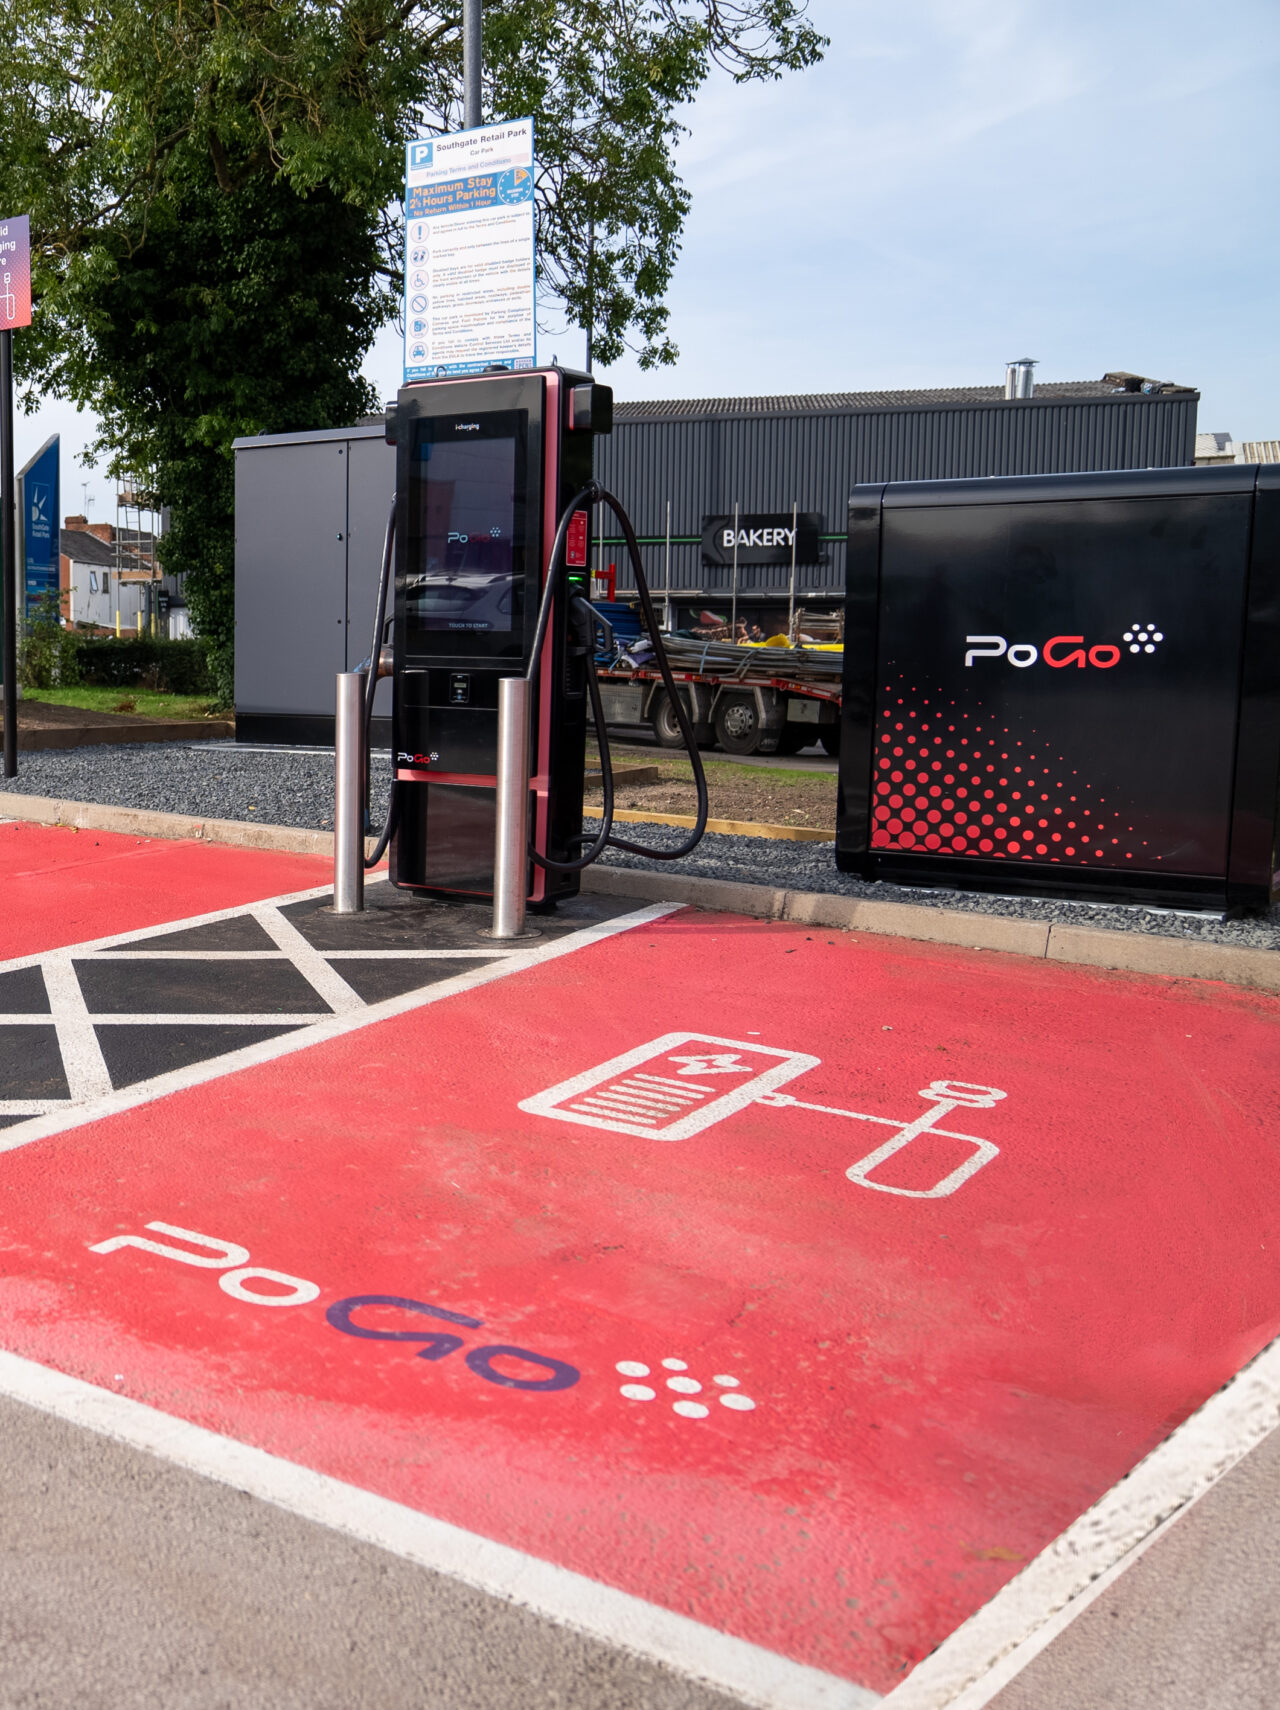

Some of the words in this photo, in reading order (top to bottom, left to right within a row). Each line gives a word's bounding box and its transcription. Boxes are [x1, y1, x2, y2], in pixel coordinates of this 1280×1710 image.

[436, 138, 478, 151] Southgate
[480, 132, 505, 143] Retail
[507, 128, 527, 139] Park
[481, 146, 493, 154] Park
[426, 168, 448, 177] Parking
[449, 164, 466, 174] Terms
[413, 181, 464, 198] Maximum
[467, 176, 494, 189] Stay
[422, 193, 453, 207] Hours
[456, 187, 496, 201] Parking
[425, 206, 446, 215] Return
[449, 202, 470, 212] Within
[475, 199, 492, 207] Hour
[723, 527, 798, 547] BAKERY
[964, 635, 1121, 669] PoGo
[397, 751, 431, 764] PoGo
[87, 1220, 581, 1392] PoGo
